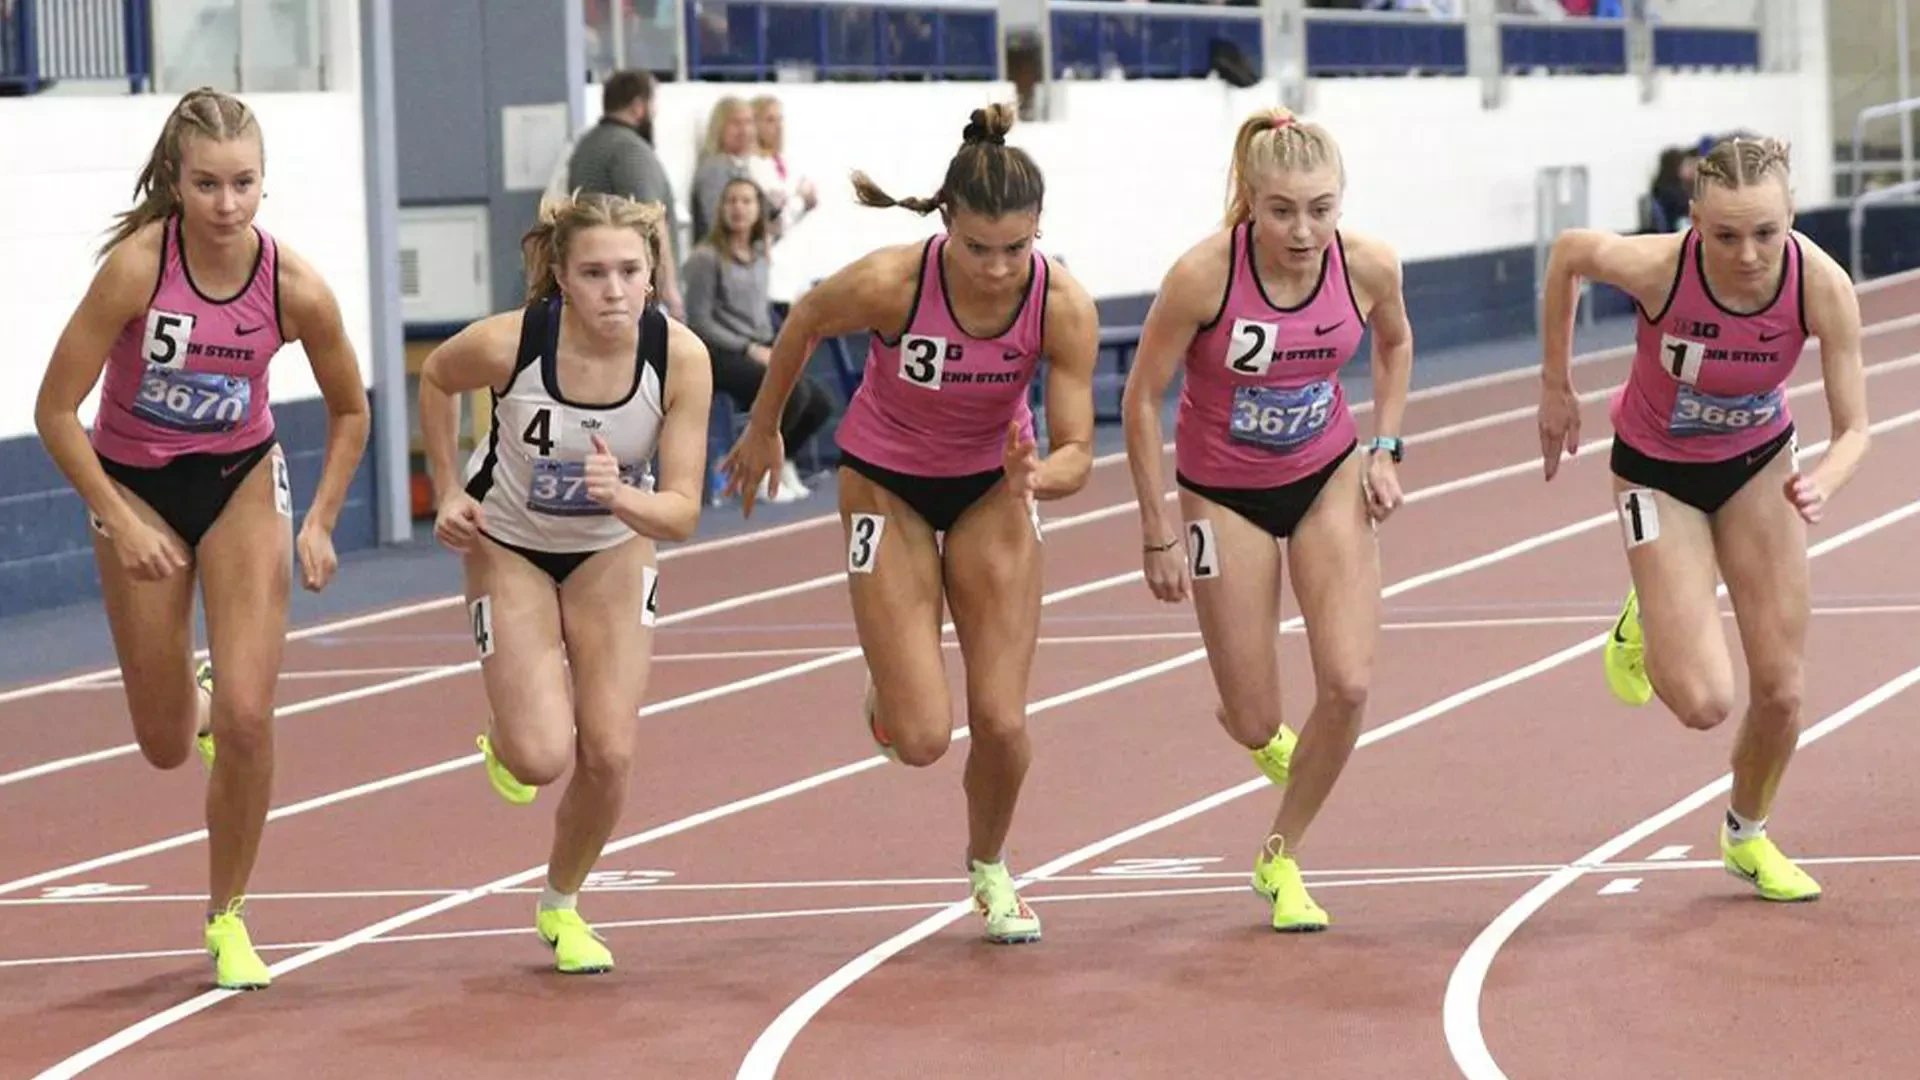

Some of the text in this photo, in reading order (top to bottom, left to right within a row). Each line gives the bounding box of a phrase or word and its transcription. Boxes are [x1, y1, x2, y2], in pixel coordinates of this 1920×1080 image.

[150, 315, 181, 364] 5
[205, 345, 255, 360] STATE
[905, 338, 937, 382] 3
[1233, 325, 1266, 372] 2
[1285, 347, 1337, 360] STATE
[1666, 343, 1688, 378] 1
[1731, 351, 1779, 362] STATE
[941, 371, 972, 382] ENN
[143, 379, 242, 421] 3670
[1234, 400, 1329, 434] 3675
[1677, 399, 1776, 426] 3687
[523, 408, 554, 456] 4
[1625, 493, 1644, 542] 1
[851, 516, 875, 568] 3
[1189, 523, 1211, 576] 2
[474, 601, 489, 653] 4
